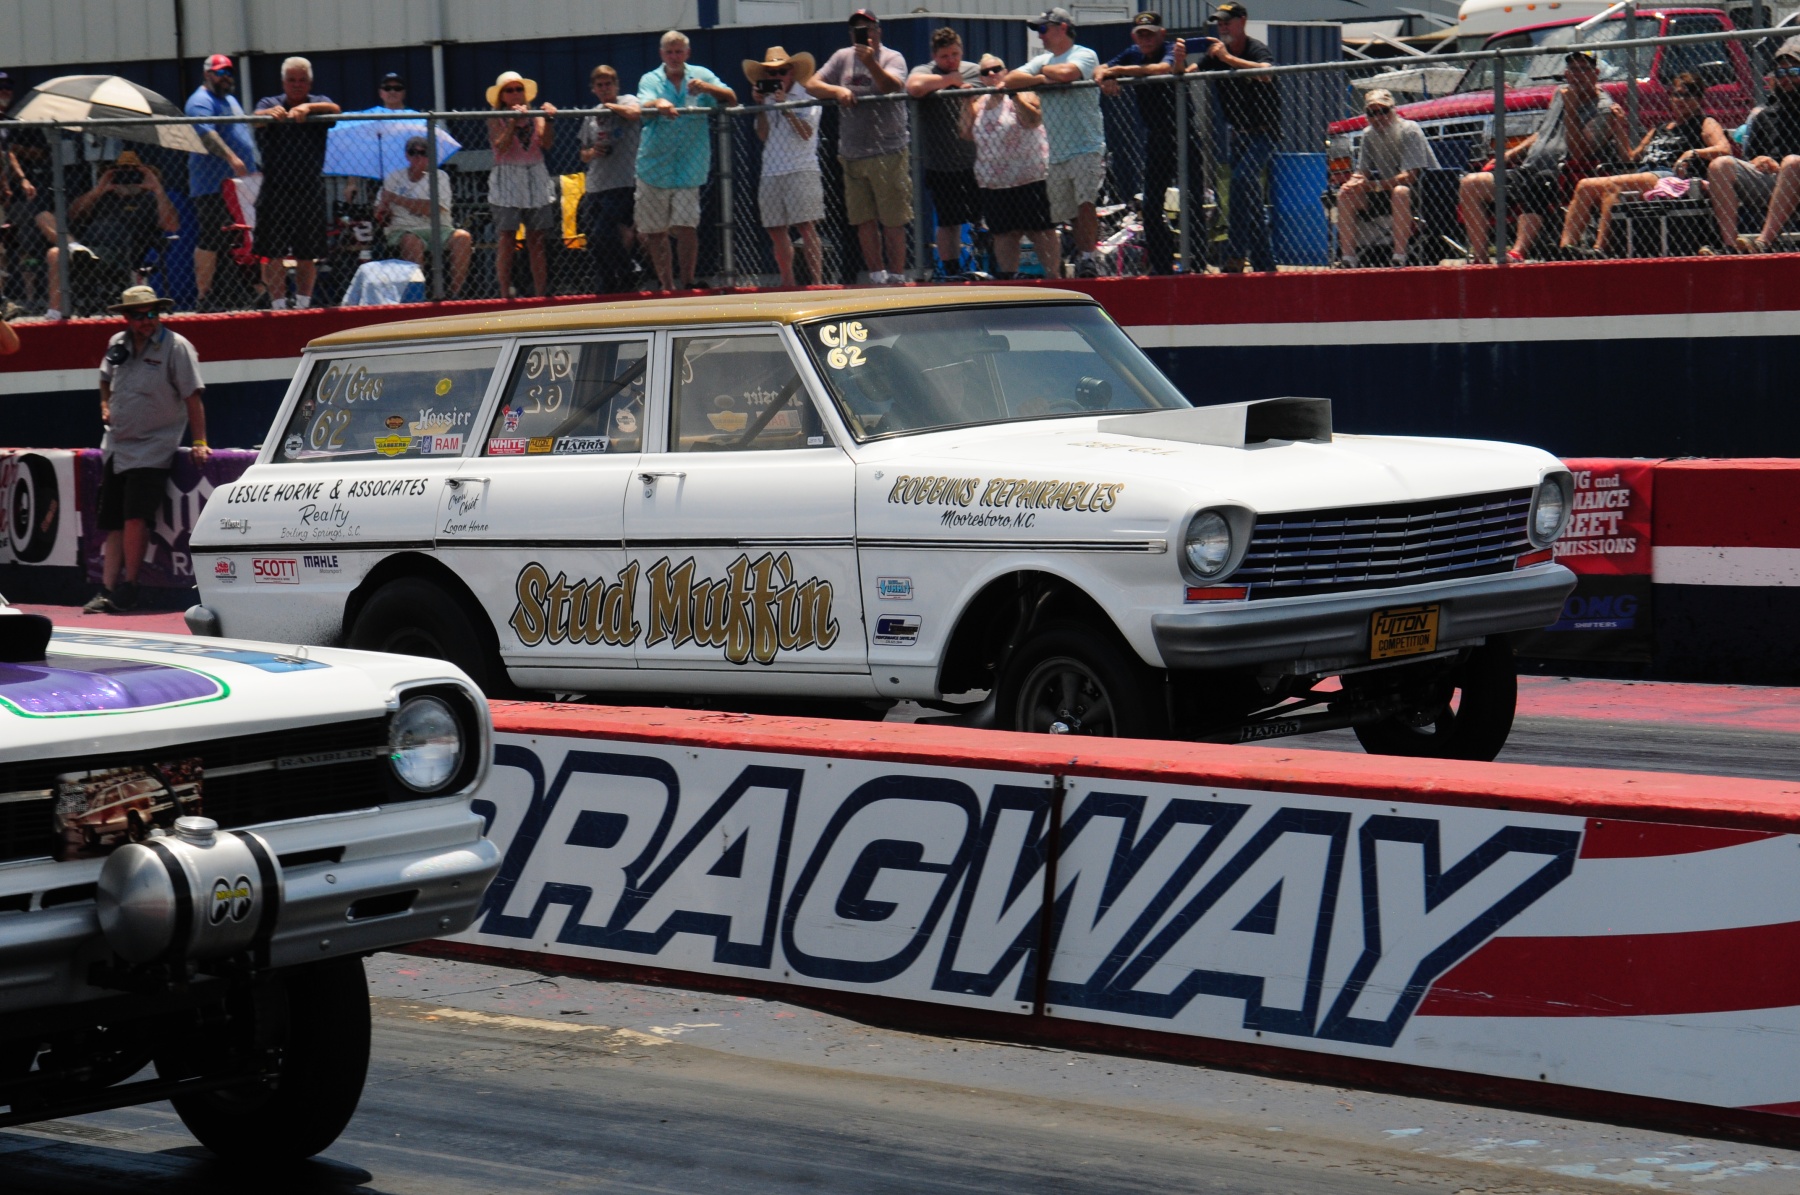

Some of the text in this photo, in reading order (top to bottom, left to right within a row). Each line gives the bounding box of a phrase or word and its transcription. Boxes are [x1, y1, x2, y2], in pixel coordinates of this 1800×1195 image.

[819, 321, 868, 348] C/G
[827, 346, 867, 370] 62
[415, 406, 472, 430] Hoosier
[311, 409, 352, 450] 62
[435, 437, 459, 450] RAM
[490, 439, 525, 449] WHITE
[227, 478, 429, 504] LESLIE HORNE & ASSOCIATES
[1594, 474, 1620, 488] and
[887, 475, 1125, 513] ROBBINS REPAIRABLES
[1572, 489, 1630, 510] MANCE
[298, 502, 350, 528] Realty
[1560, 511, 1623, 538] REET
[280, 527, 308, 541] Boiling
[348, 526, 361, 536] S.C.
[442, 518, 467, 535] Logan
[1552, 538, 1636, 556] SMISSIONS
[217, 561, 229, 569] Hub
[253, 560, 296, 576] SCOTT
[303, 555, 339, 567] MAHLE
[508, 551, 840, 665] Stud Muffin
[1562, 594, 1638, 618] ONG
[1374, 613, 1431, 637] FULTON
[1378, 634, 1430, 651] COMPETITION
[280, 749, 373, 767] RAMBLER
